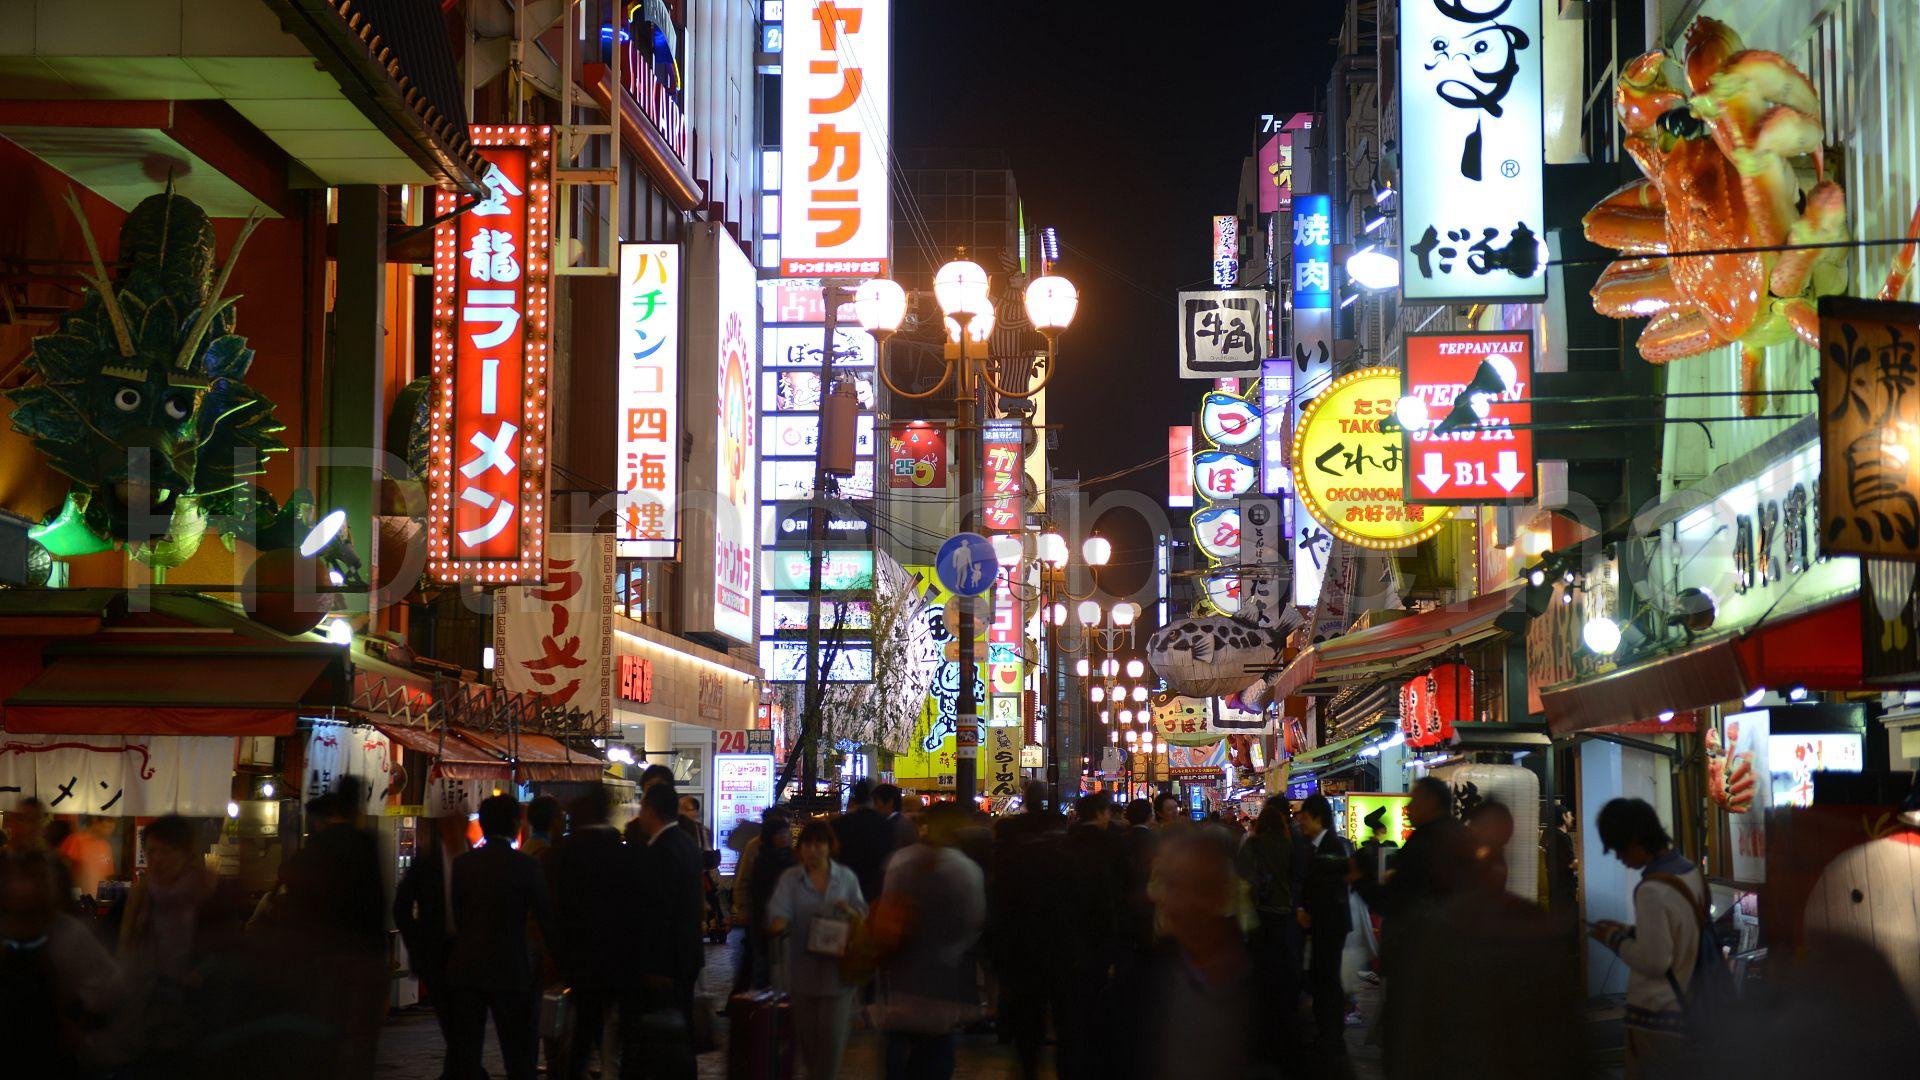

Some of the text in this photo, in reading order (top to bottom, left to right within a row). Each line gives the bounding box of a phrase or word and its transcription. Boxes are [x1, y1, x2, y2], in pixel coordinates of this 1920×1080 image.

[1294, 214, 1330, 290] 焼肉
[1411, 224, 1533, 279] だる
[1196, 313, 1253, 354] 牛角
[1439, 342, 1524, 355] TEPPANYAKI
[895, 458, 915, 475] 25
[989, 447, 1018, 525] カラオケ
[1455, 462, 1488, 485] B1
[520, 559, 588, 707] ラーメン
[720, 731, 745, 753] 24
